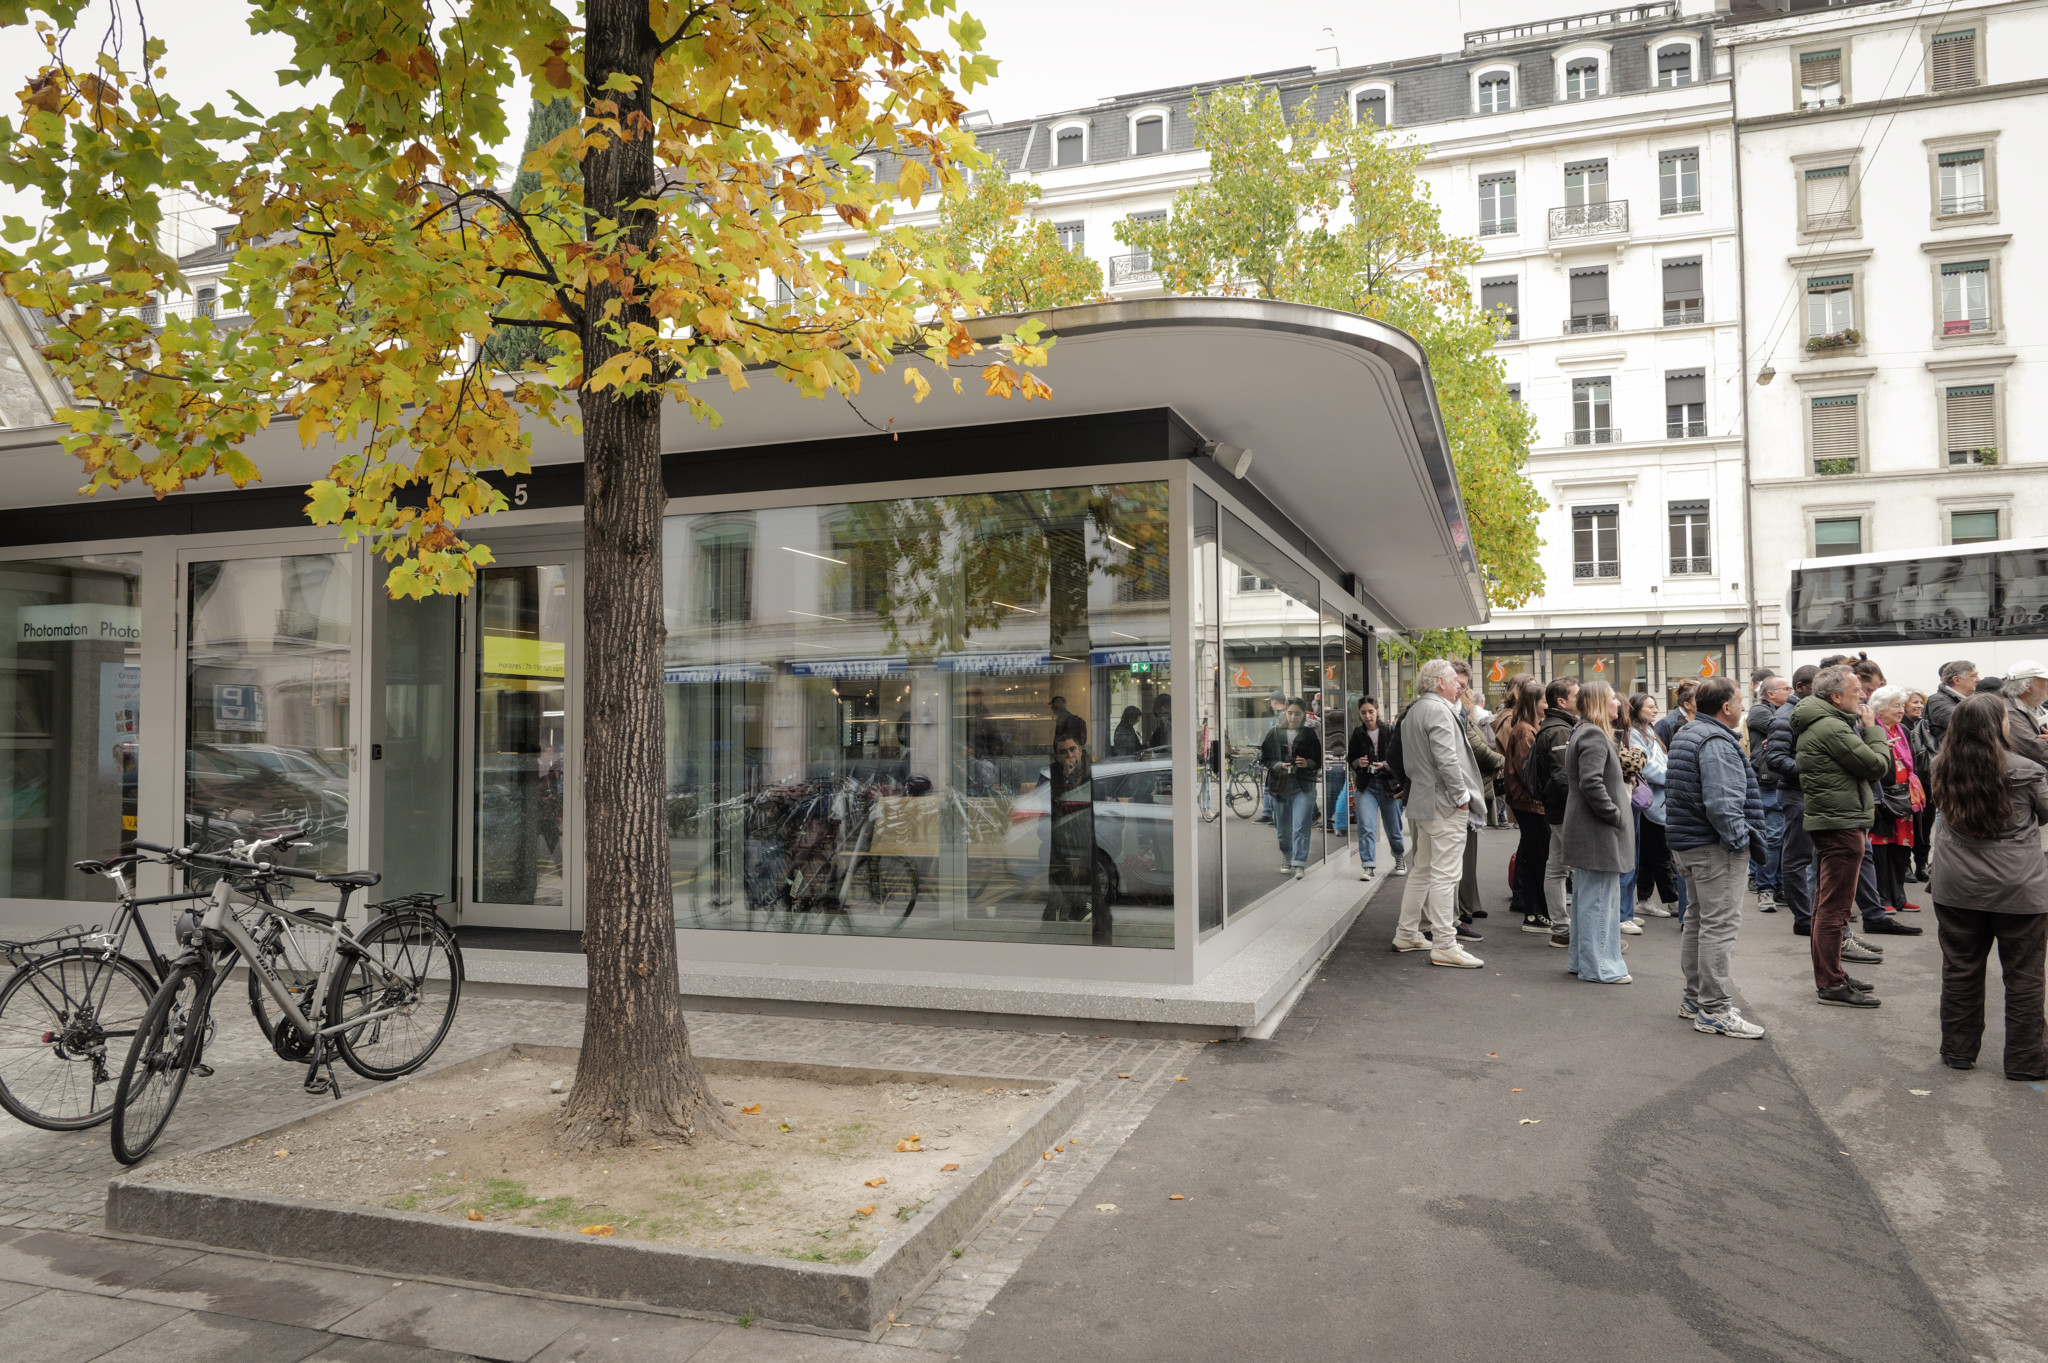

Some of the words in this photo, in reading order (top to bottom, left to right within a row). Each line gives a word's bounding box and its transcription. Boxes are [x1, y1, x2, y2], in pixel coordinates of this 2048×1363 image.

[515, 484, 528, 506] 5
[24, 623, 88, 638] Photomaton
[101, 621, 140, 639] Photo
